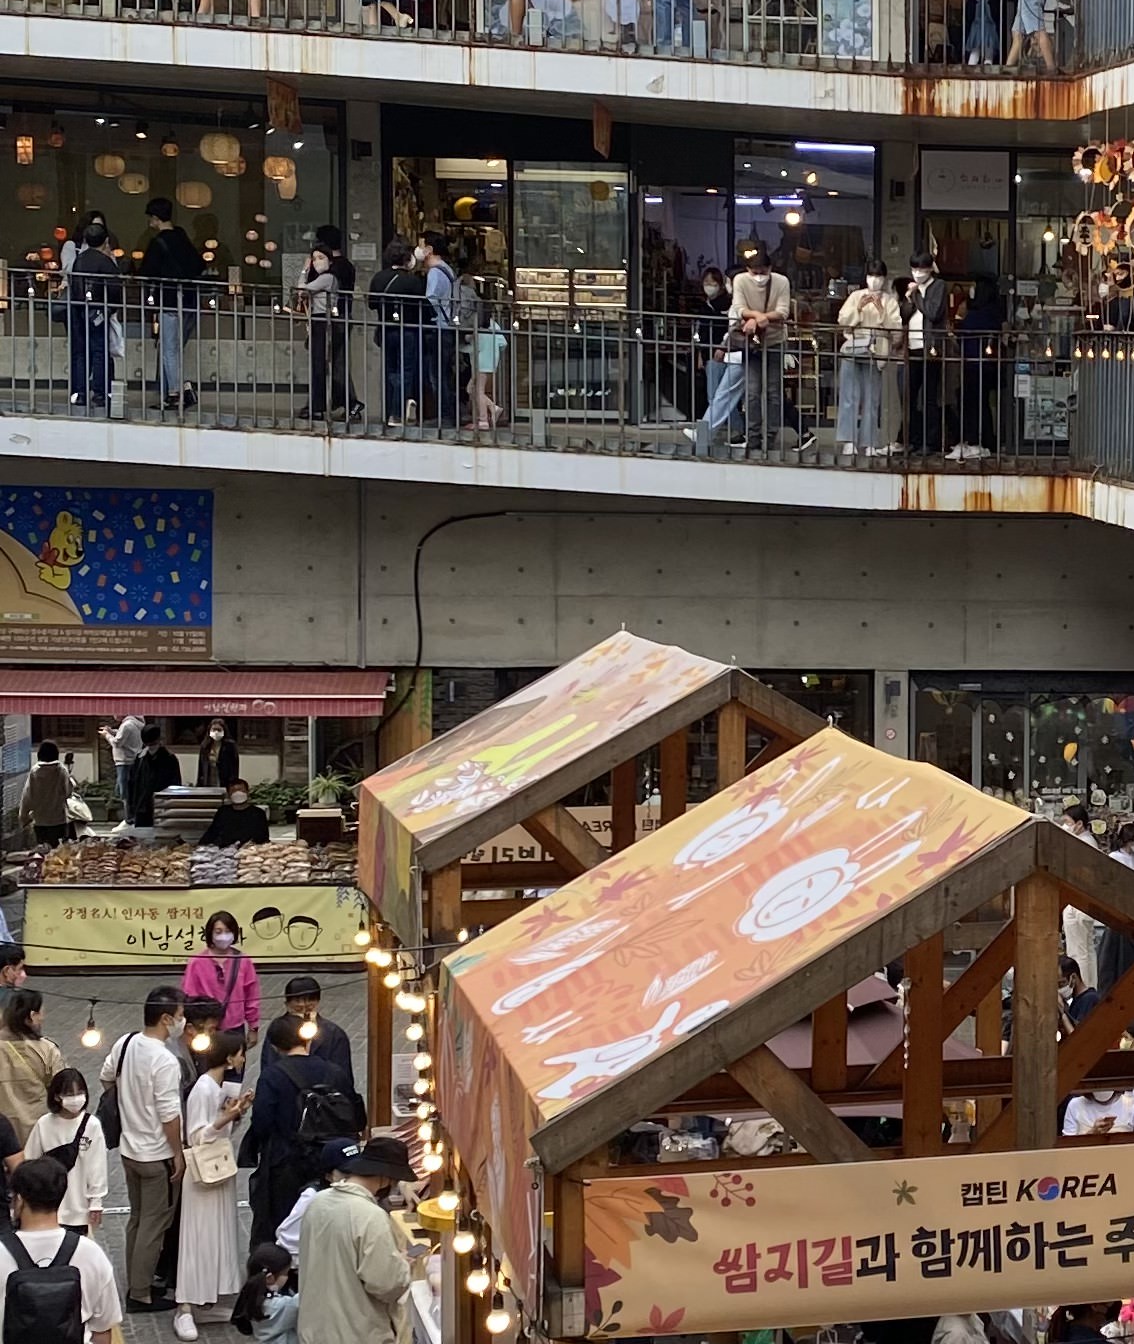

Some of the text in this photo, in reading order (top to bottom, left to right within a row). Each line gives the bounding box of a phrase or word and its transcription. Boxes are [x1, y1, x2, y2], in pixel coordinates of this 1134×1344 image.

[121, 906, 160, 921] 인사동
[166, 905, 205, 920] 쌈지길
[960, 1172, 1118, 1209] 캡틴 KOREA
[712, 1232, 901, 1295] 쌈지길과
[910, 1222, 1093, 1281] 함께하는
